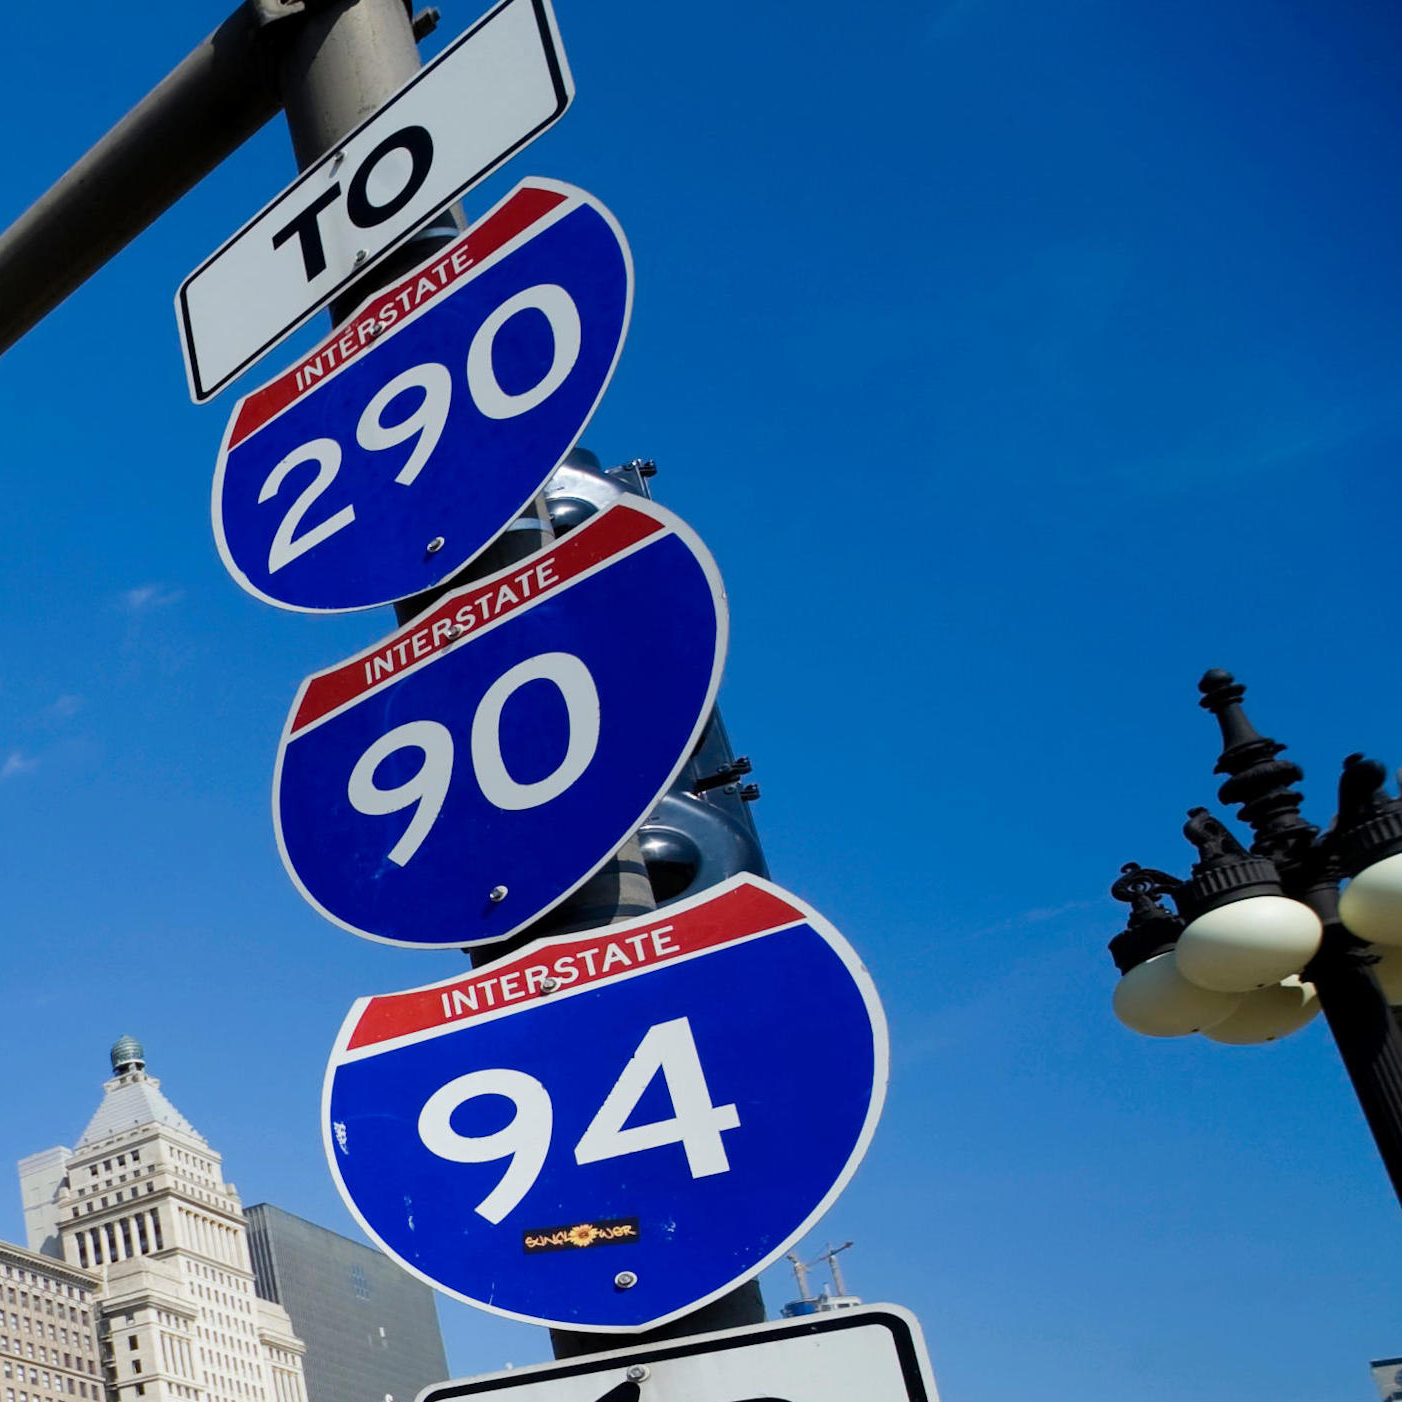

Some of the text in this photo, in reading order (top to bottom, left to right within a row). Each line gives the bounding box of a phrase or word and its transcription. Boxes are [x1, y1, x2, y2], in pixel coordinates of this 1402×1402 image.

[272, 124, 434, 283] TO
[295, 244, 474, 391] INTERSTATE
[257, 283, 582, 575] 290
[364, 558, 560, 685] INTERSTATE
[347, 652, 600, 868] 90
[441, 925, 681, 1019] INTERSTATE
[418, 1016, 741, 1225] 94
